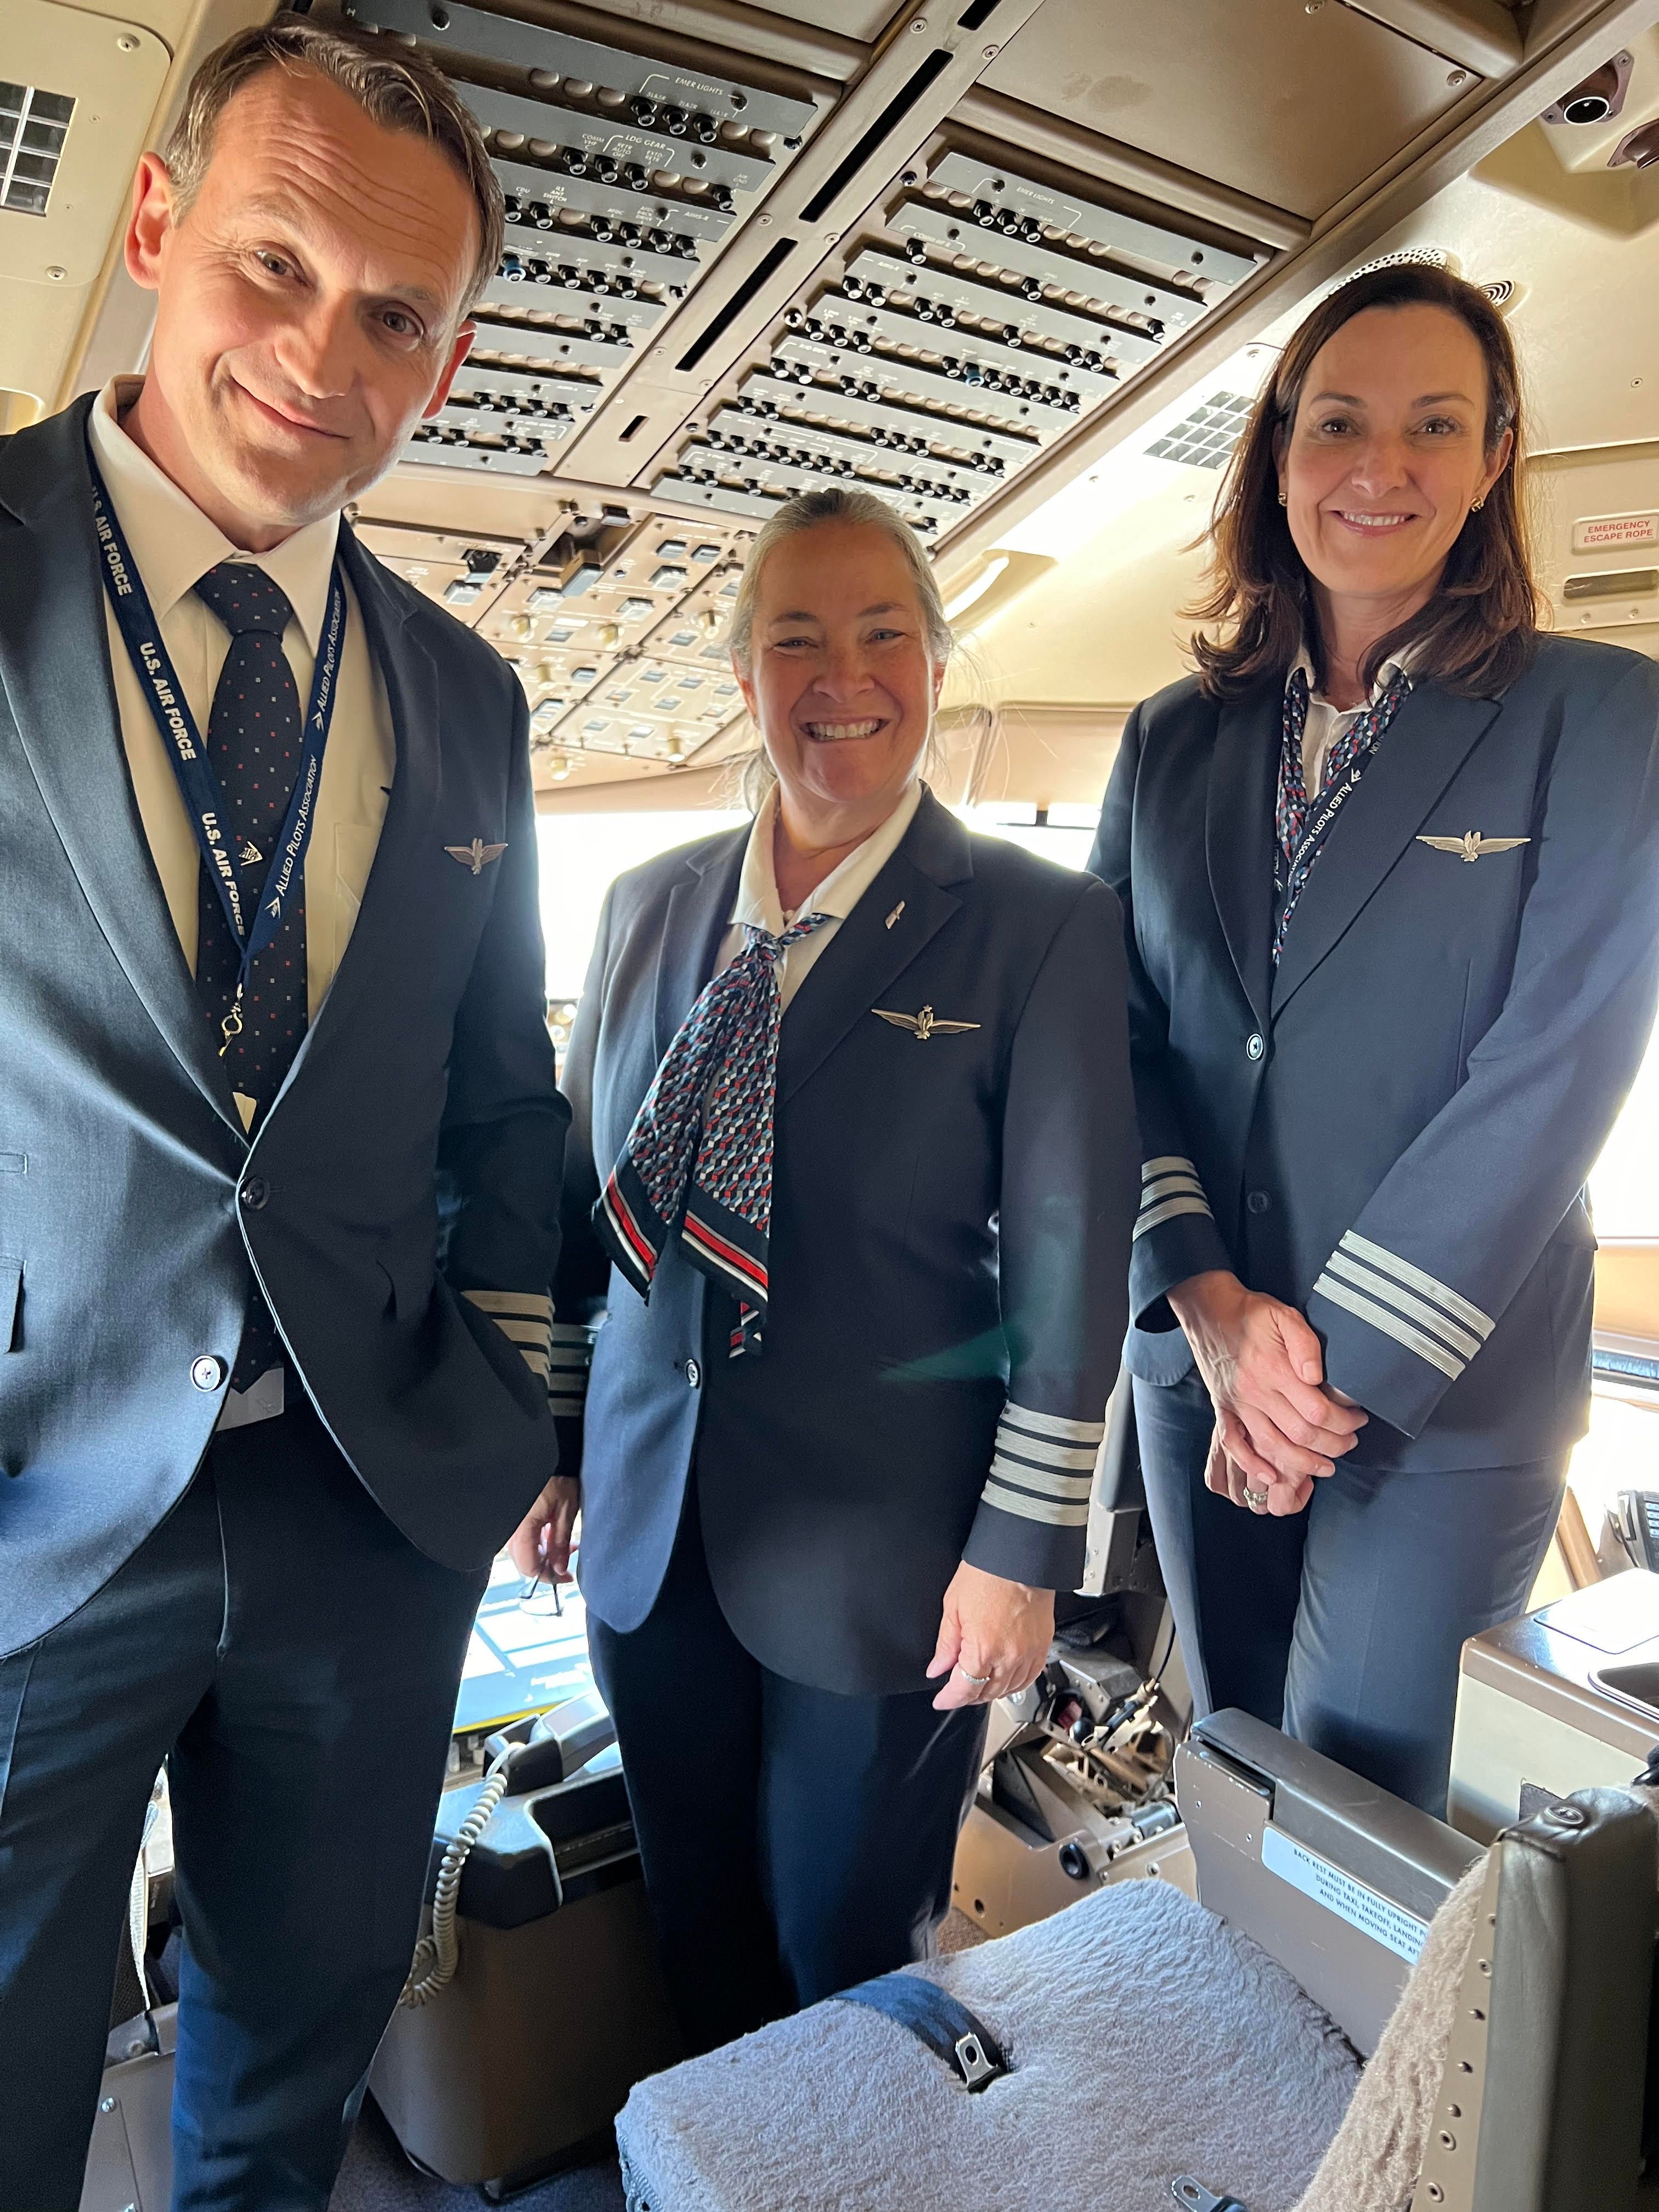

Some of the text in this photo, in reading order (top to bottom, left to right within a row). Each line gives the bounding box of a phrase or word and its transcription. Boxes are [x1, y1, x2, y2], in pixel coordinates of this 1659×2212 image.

[675, 77, 724, 96] EMER LIGHTS
[612, 146, 631, 155] AUTO
[625, 134, 666, 150] LDG GEAR
[1032, 192, 1055, 205] LIGHTS
[1584, 529, 1654, 543] ESCAPE ROPE
[1588, 520, 1650, 533] EMERGENCY
[95, 516, 112, 543] AIR
[104, 542, 132, 596] FORCE
[140, 641, 197, 761] U.S. AIR FORCE
[202, 812, 245, 936] U.S. AIR FORCE
[1294, 1848, 1310, 1864] BACK
[1312, 1860, 1327, 1875] REST
[1328, 1871, 1345, 1887] MUST
[1357, 1890, 1365, 1900] IN
[1367, 1896, 1386, 1912] FULLY
[1387, 1909, 1418, 1933] UPRIGHT
[1316, 1874, 1341, 1895] DURING
[1319, 1889, 1334, 1901] AND
[1336, 1898, 1357, 1917] WHEN
[1358, 1914, 1387, 1937] MOVING
[1390, 1933, 1406, 1949] SEAT
